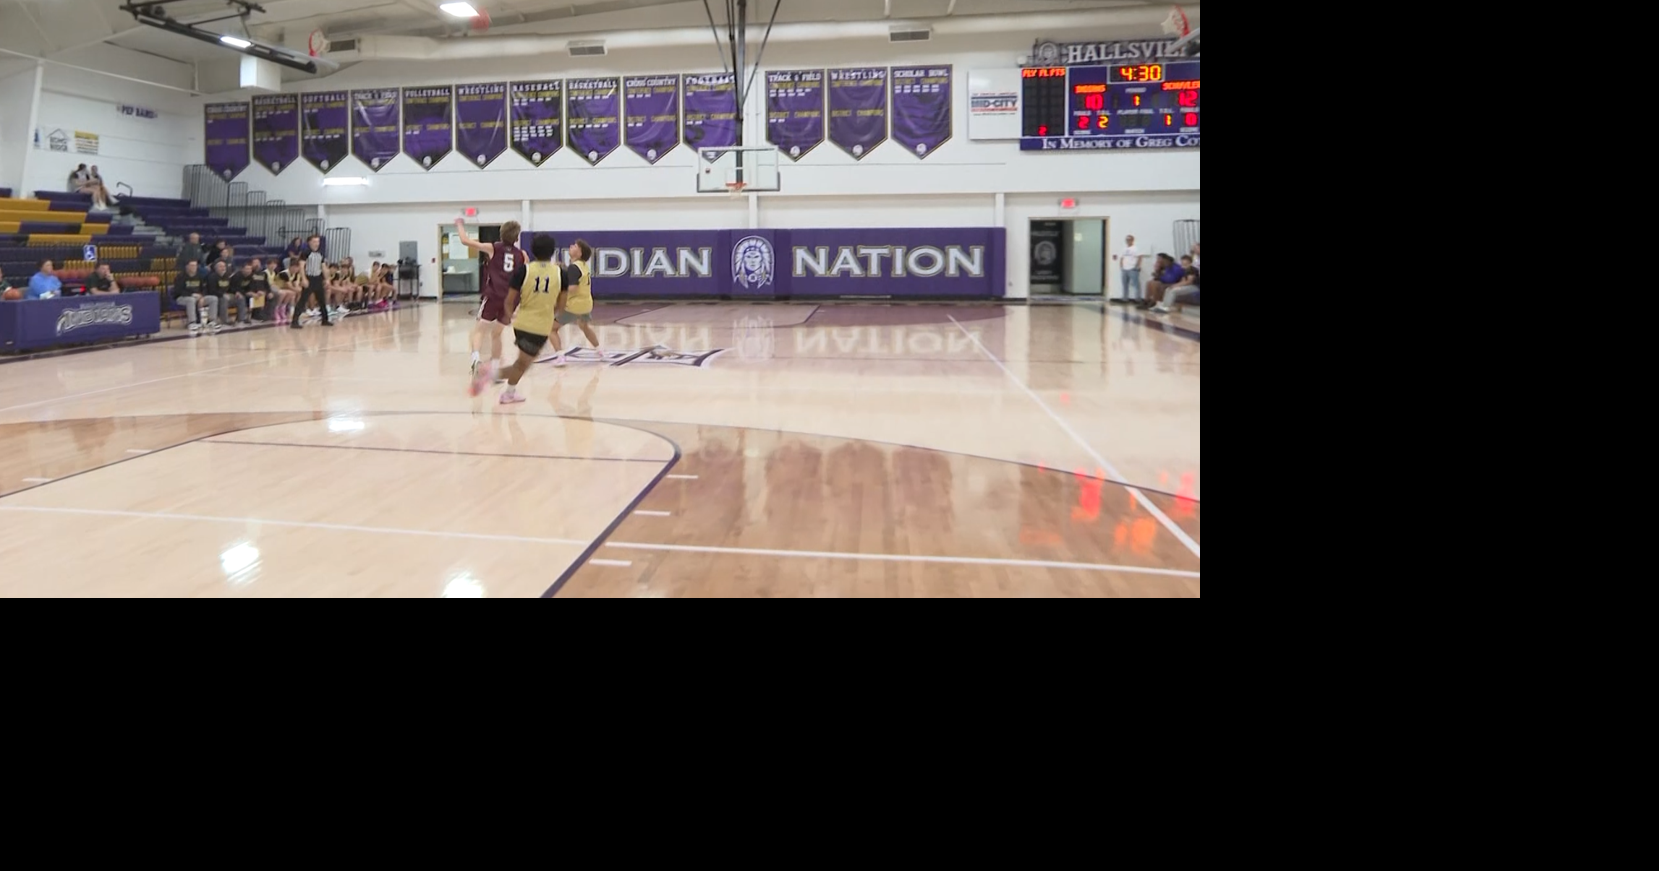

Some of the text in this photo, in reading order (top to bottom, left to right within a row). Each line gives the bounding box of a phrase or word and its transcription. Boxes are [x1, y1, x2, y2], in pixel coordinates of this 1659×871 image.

[831, 70, 886, 80] WRESTLING
[1120, 65, 1162, 81] 4:30
[513, 81, 560, 92] BASEBALL
[569, 81, 617, 90] BASKETBALL
[1085, 94, 1104, 110] 10
[1133, 95, 1140, 107] 1
[1179, 91, 1198, 108] 12
[1078, 116, 1090, 129] 2
[1098, 116, 1109, 129] 2
[1165, 114, 1172, 126] 1
[1038, 126, 1047, 136] 2
[503, 254, 514, 272] 5
[792, 246, 985, 278] NATION
[534, 276, 550, 293] 11
